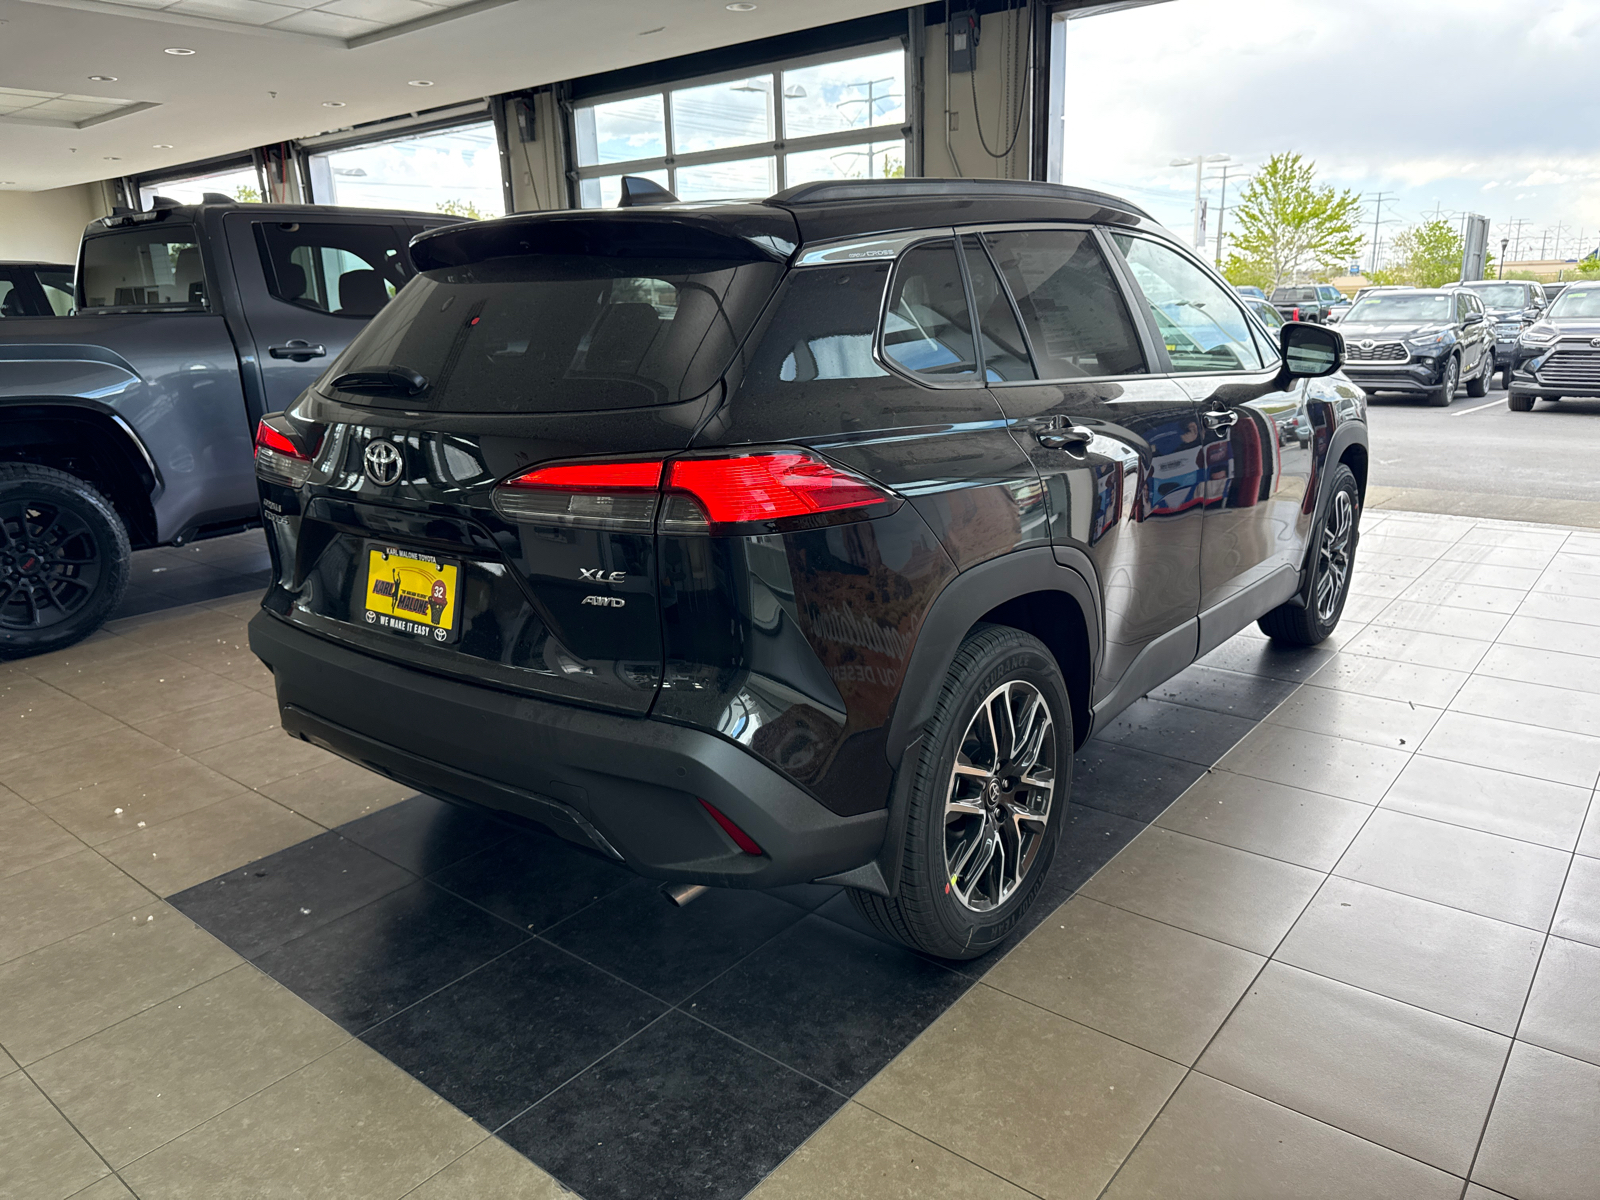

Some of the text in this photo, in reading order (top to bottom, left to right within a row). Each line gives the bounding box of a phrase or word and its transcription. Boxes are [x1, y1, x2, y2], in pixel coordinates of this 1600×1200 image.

[386, 547, 437, 564] KARL MALONE TOYOTA
[578, 567, 626, 584] XLE
[372, 578, 395, 598] KARL
[433, 585, 444, 599] 32
[397, 594, 430, 616] MALONE
[580, 595, 626, 608] AWD
[380, 615, 430, 637] WE MAKE IT EASY
[973, 655, 1030, 706] ASSURANCE
